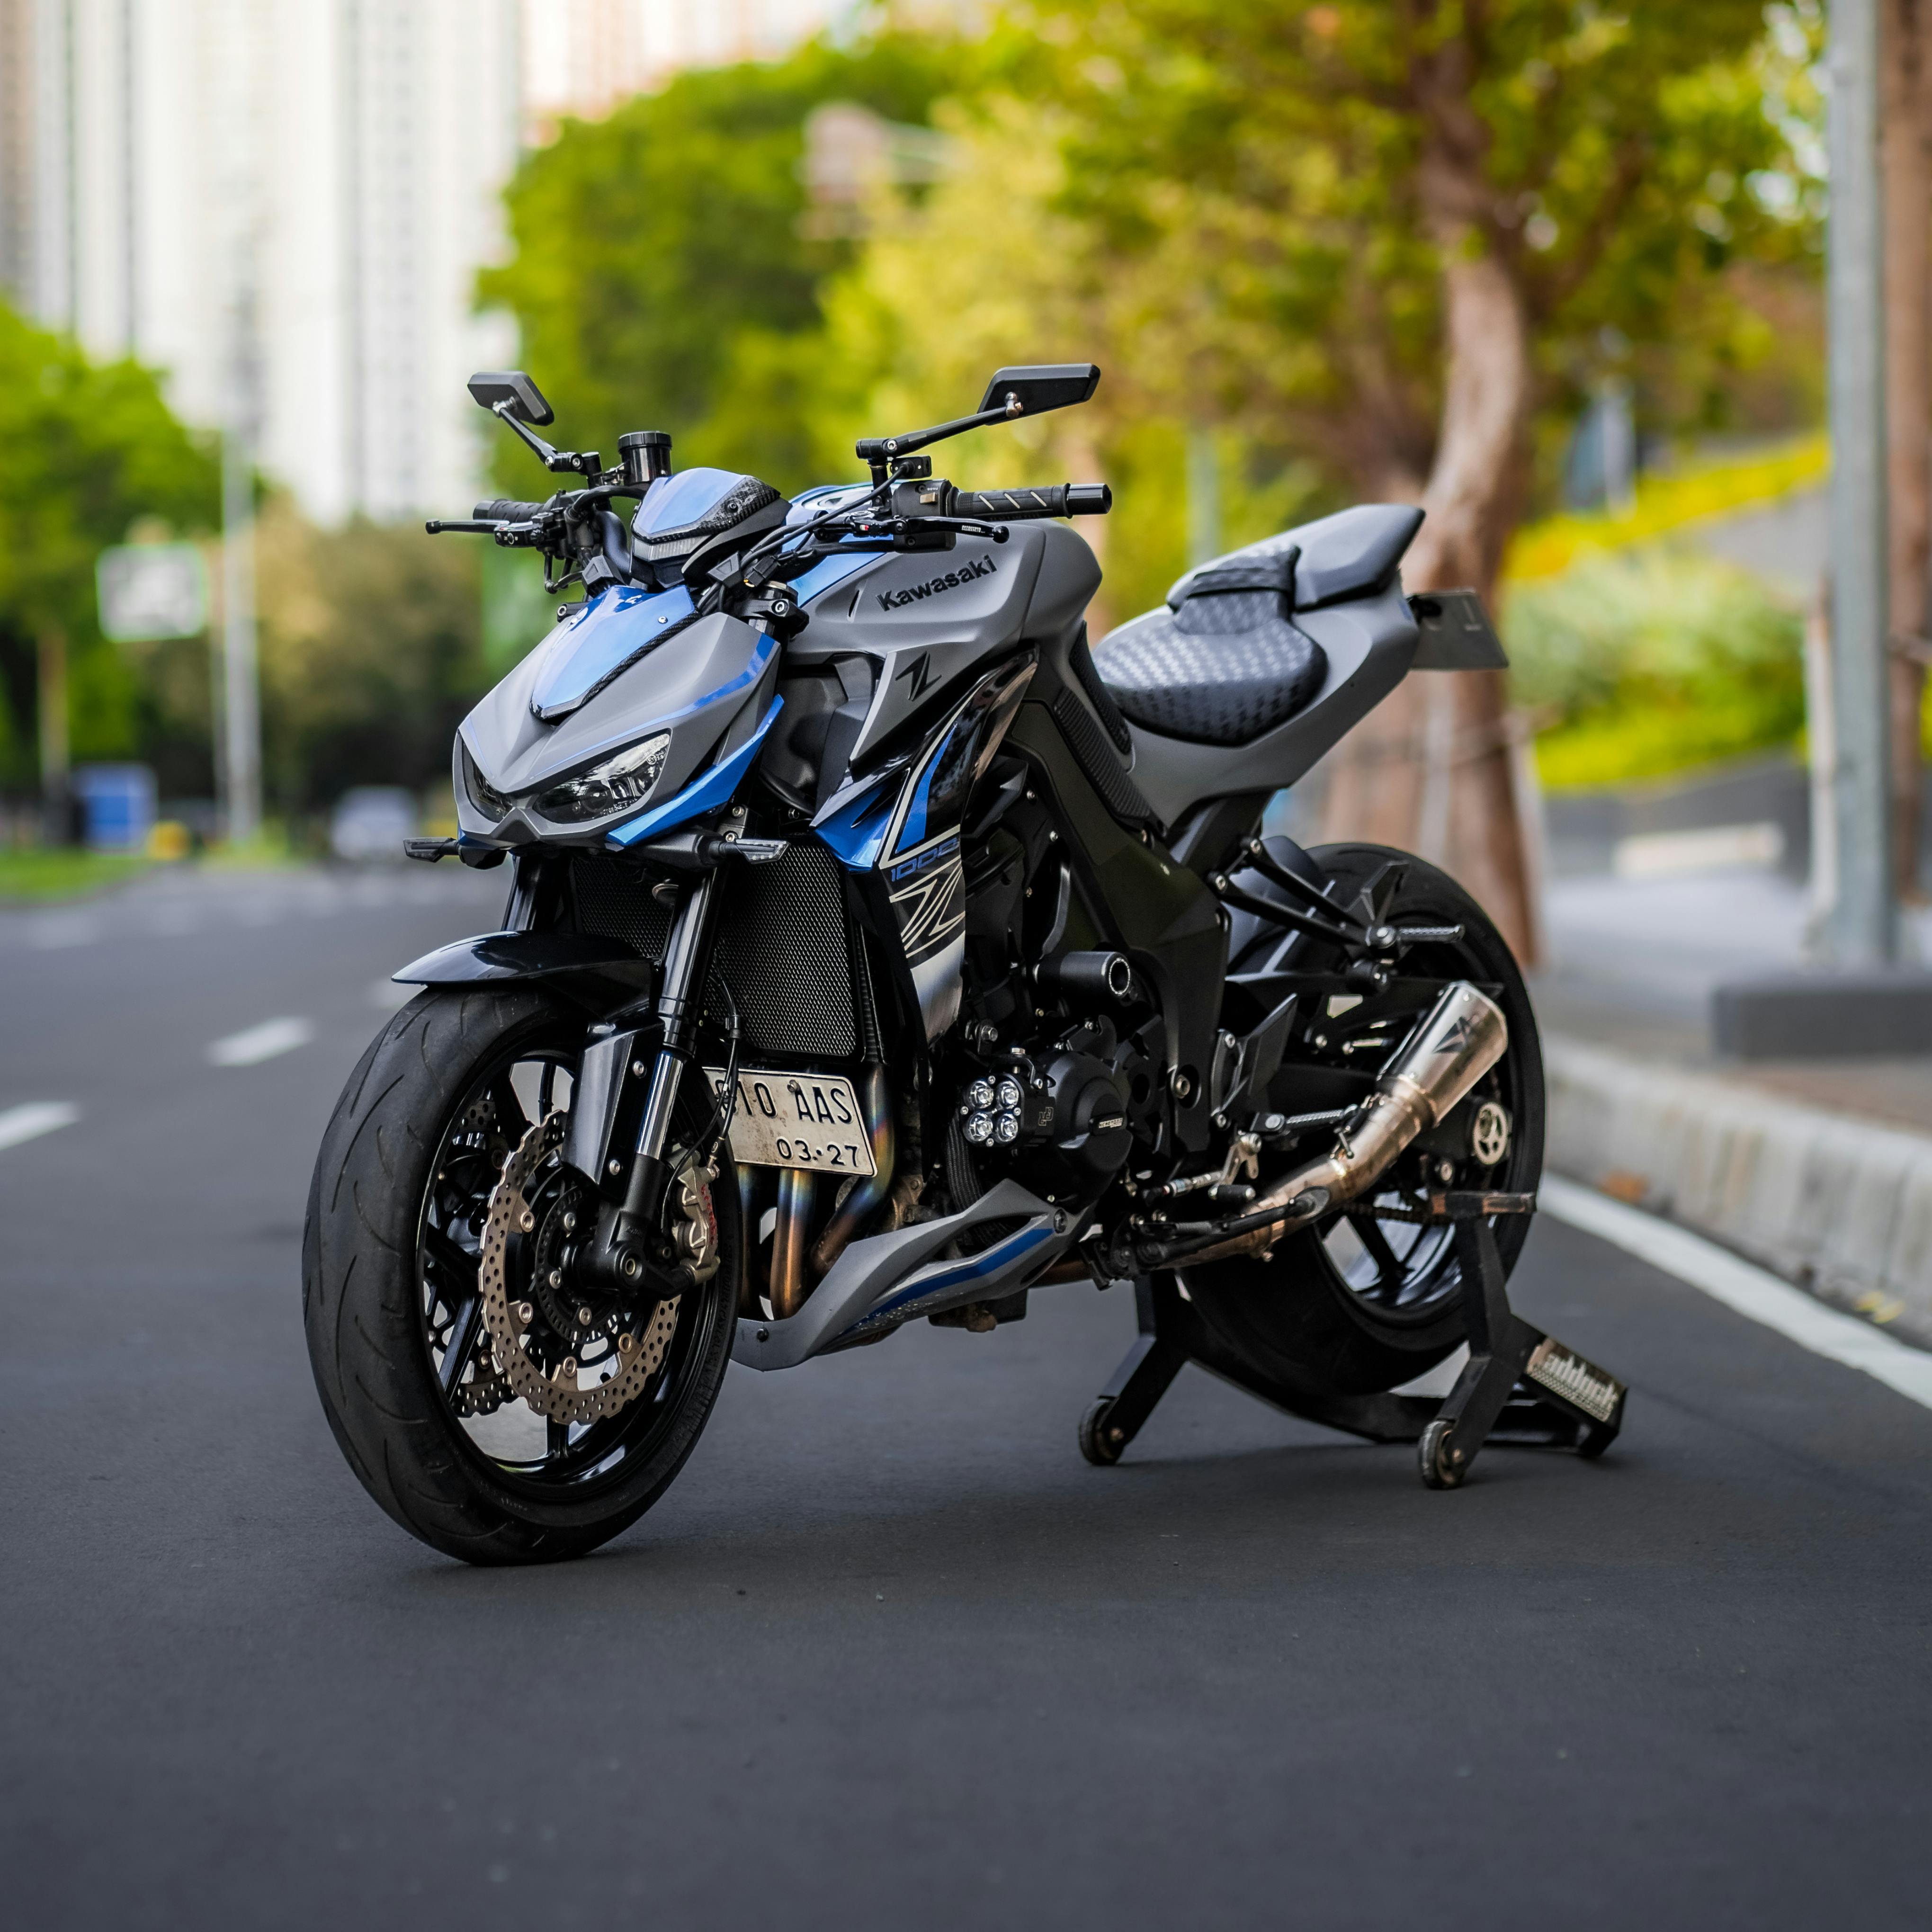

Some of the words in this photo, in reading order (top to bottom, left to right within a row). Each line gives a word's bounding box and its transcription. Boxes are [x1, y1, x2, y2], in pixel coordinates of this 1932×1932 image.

[876, 555, 997, 612] Kawasaki
[895, 650, 942, 702] Z
[794, 1086, 852, 1124] AAS
